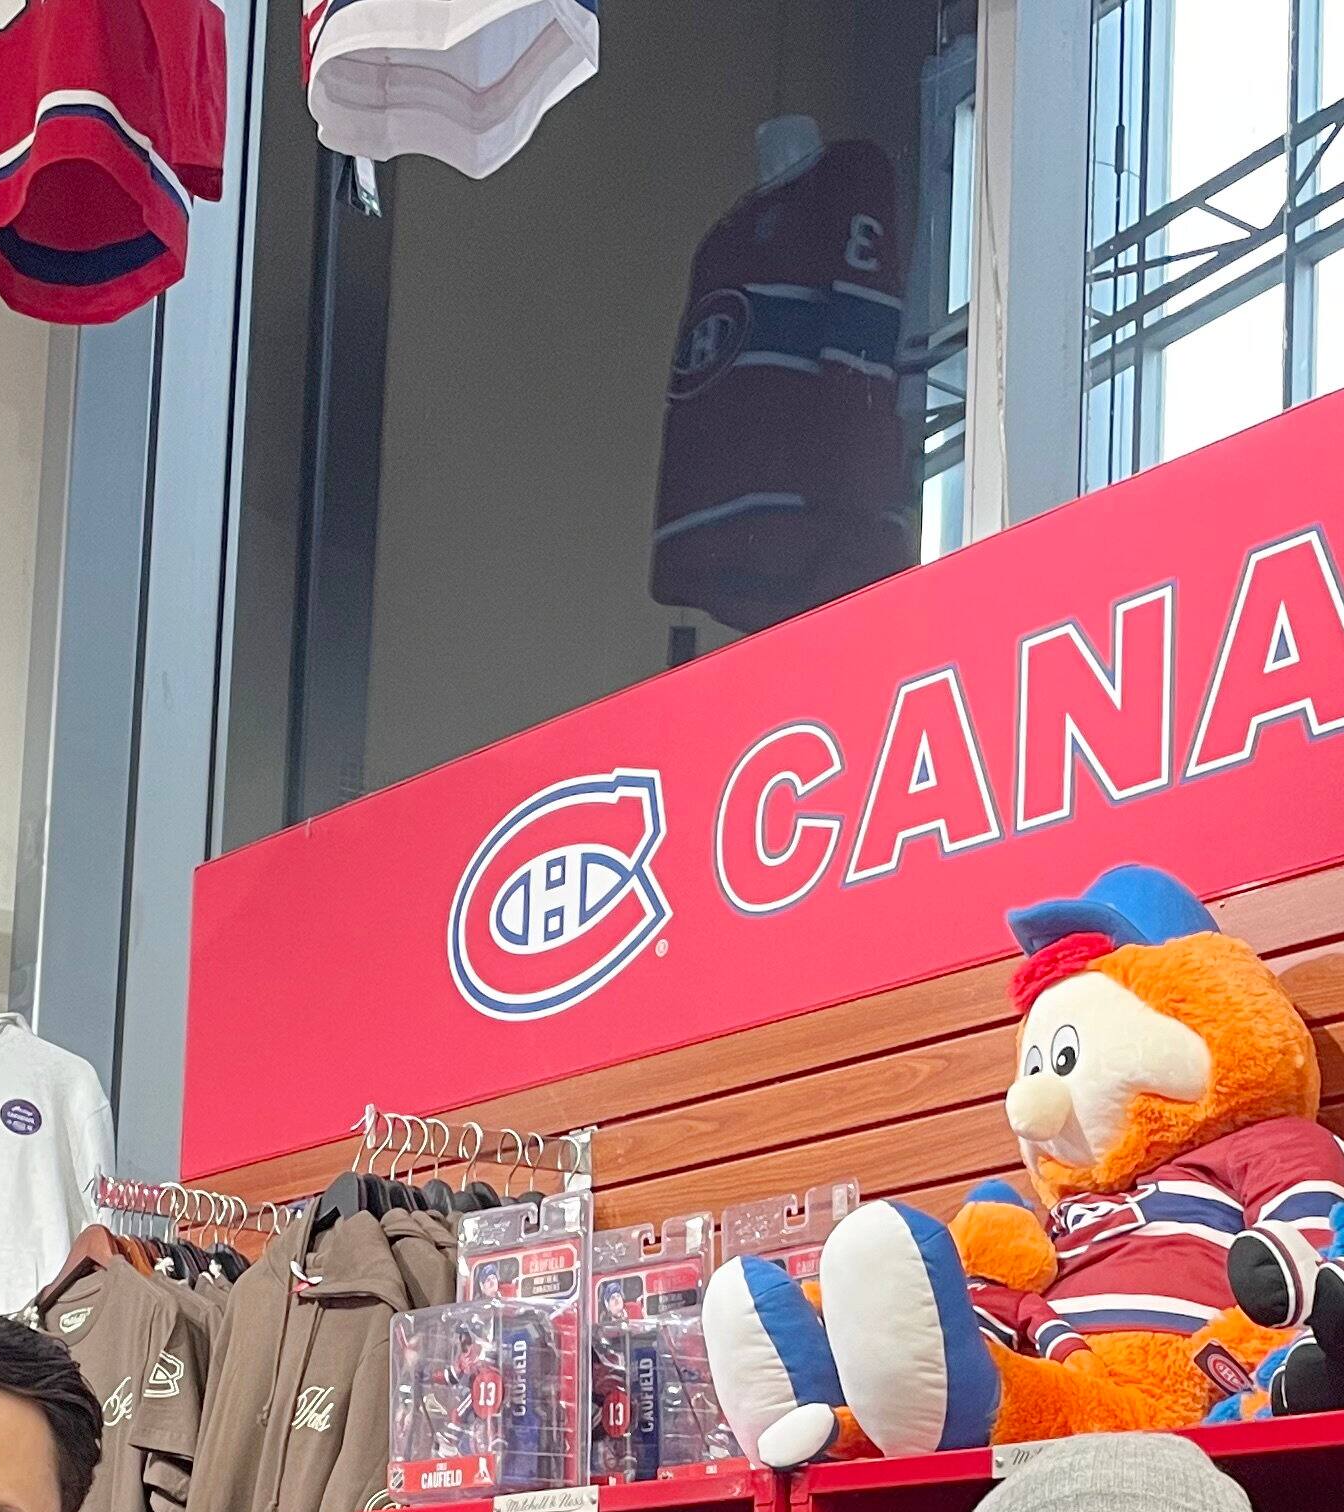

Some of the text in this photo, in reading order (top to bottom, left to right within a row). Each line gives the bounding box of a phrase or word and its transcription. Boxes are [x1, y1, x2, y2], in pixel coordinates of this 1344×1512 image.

[479, 1381, 497, 1407] 13
[639, 1357, 655, 1433] CAUFIELD
[609, 1402, 624, 1426] 13
[420, 1469, 462, 1489] CAUFIELD
[557, 1493, 585, 1507] Ness
